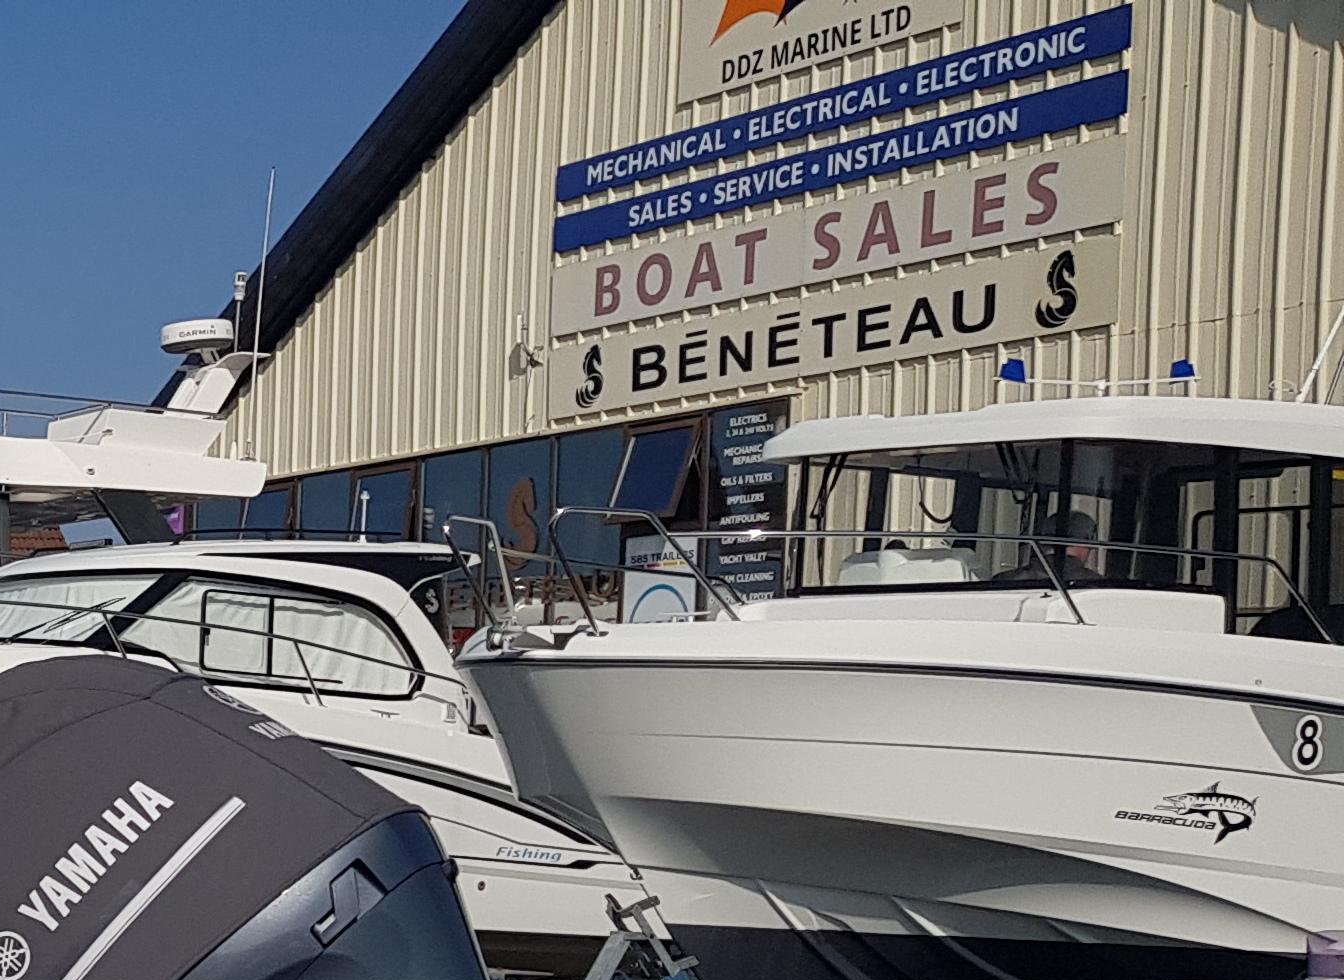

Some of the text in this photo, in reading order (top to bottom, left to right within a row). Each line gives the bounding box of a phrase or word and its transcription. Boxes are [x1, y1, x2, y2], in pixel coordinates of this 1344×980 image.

[721, 5, 911, 84] DDZ MARINE LTD
[586, 27, 1087, 186] MECHANICAL ELECTRICAL ELECTRONIC
[628, 107, 1020, 228] SALES SERVICE INSTALLATION
[594, 161, 1060, 317] BOAT SALES
[178, 328, 216, 338] GARMIN
[723, 444, 763, 457] MECHANIC
[720, 476, 737, 487] OILS
[745, 472, 773, 484] FILTERS
[726, 493, 765, 505] IMPELLERS
[719, 512, 771, 526] ANTIFOULING
[650, 549, 695, 562] TRAILES
[719, 551, 768, 565] YACHT VALET
[736, 571, 774, 583] CLEANING
[1295, 717, 1321, 768] 8
[17, 780, 175, 932] YAMAHA
[495, 846, 562, 863] Fishing
